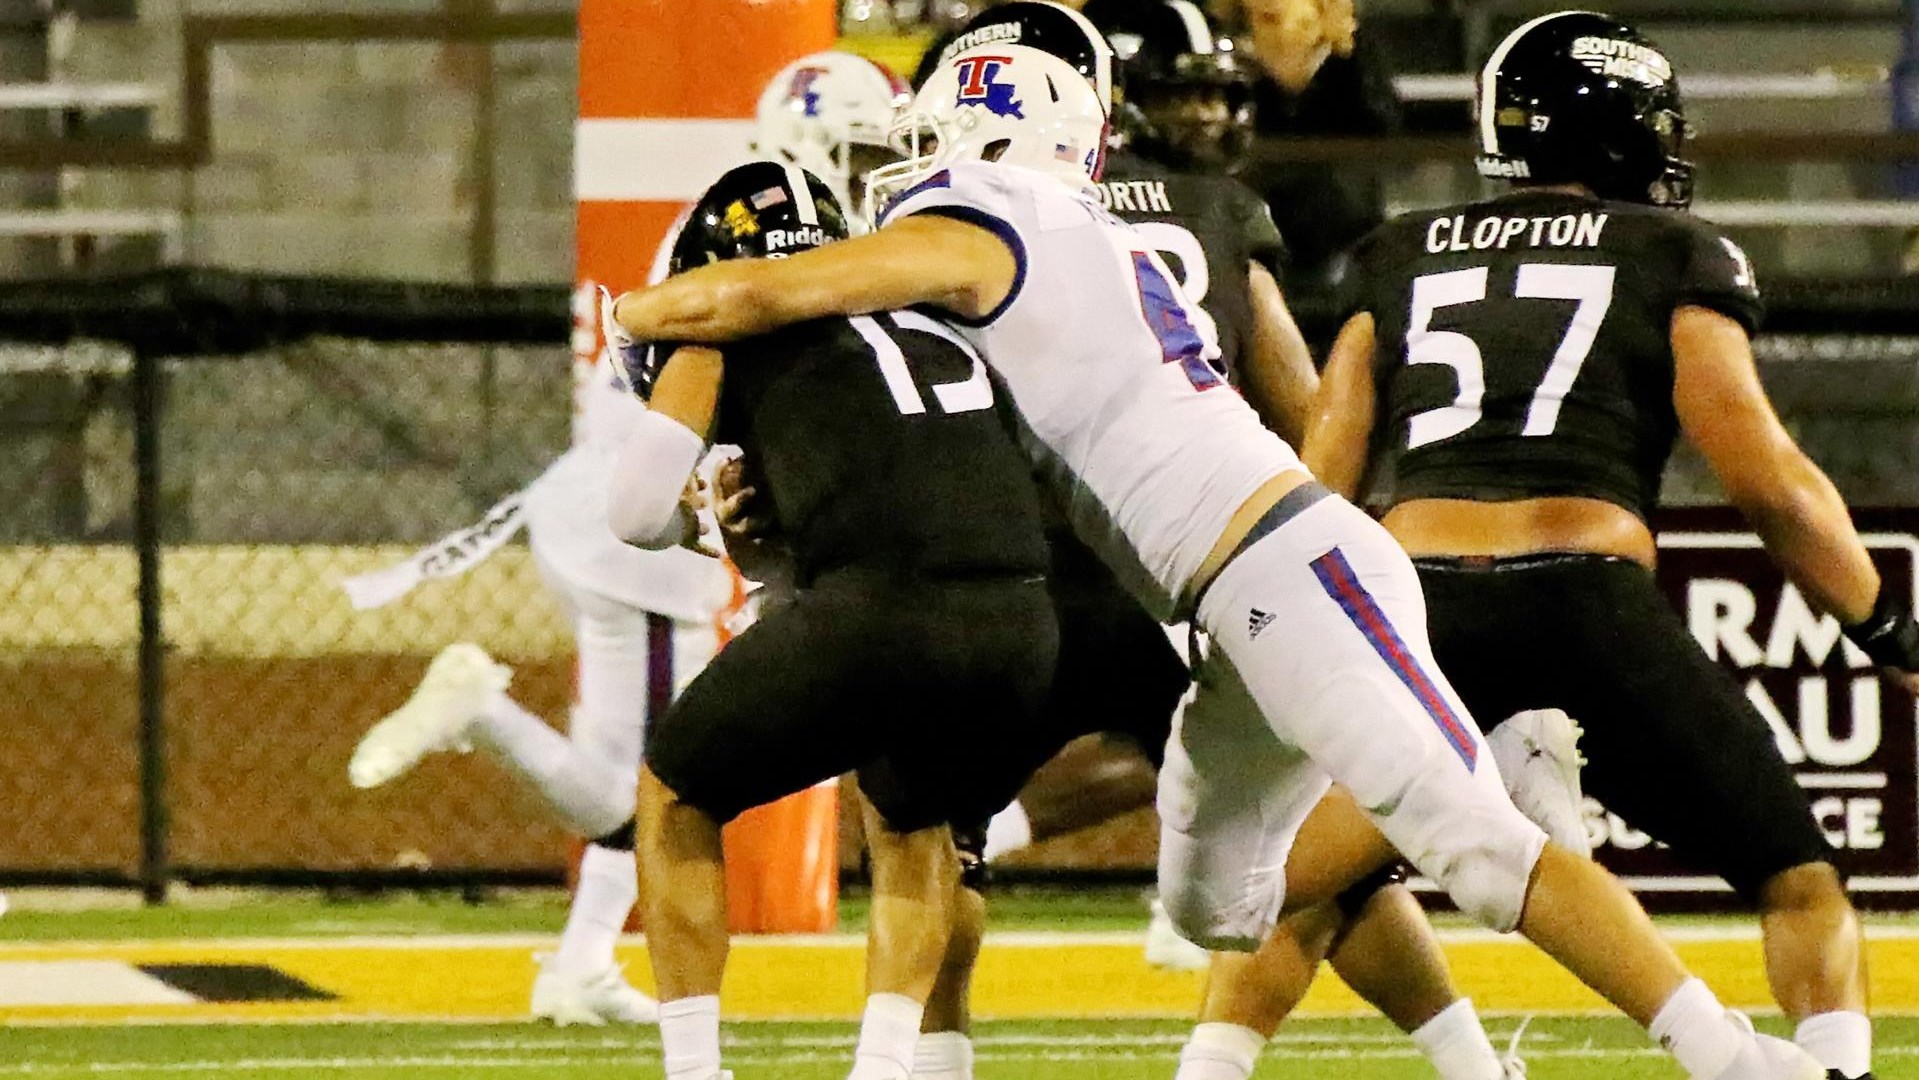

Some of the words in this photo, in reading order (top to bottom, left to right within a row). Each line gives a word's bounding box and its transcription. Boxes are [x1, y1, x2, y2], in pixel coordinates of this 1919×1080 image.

[1530, 114, 1551, 132] 57
[1426, 213, 1609, 254] CLOPTON
[1405, 263, 1617, 450] 57
